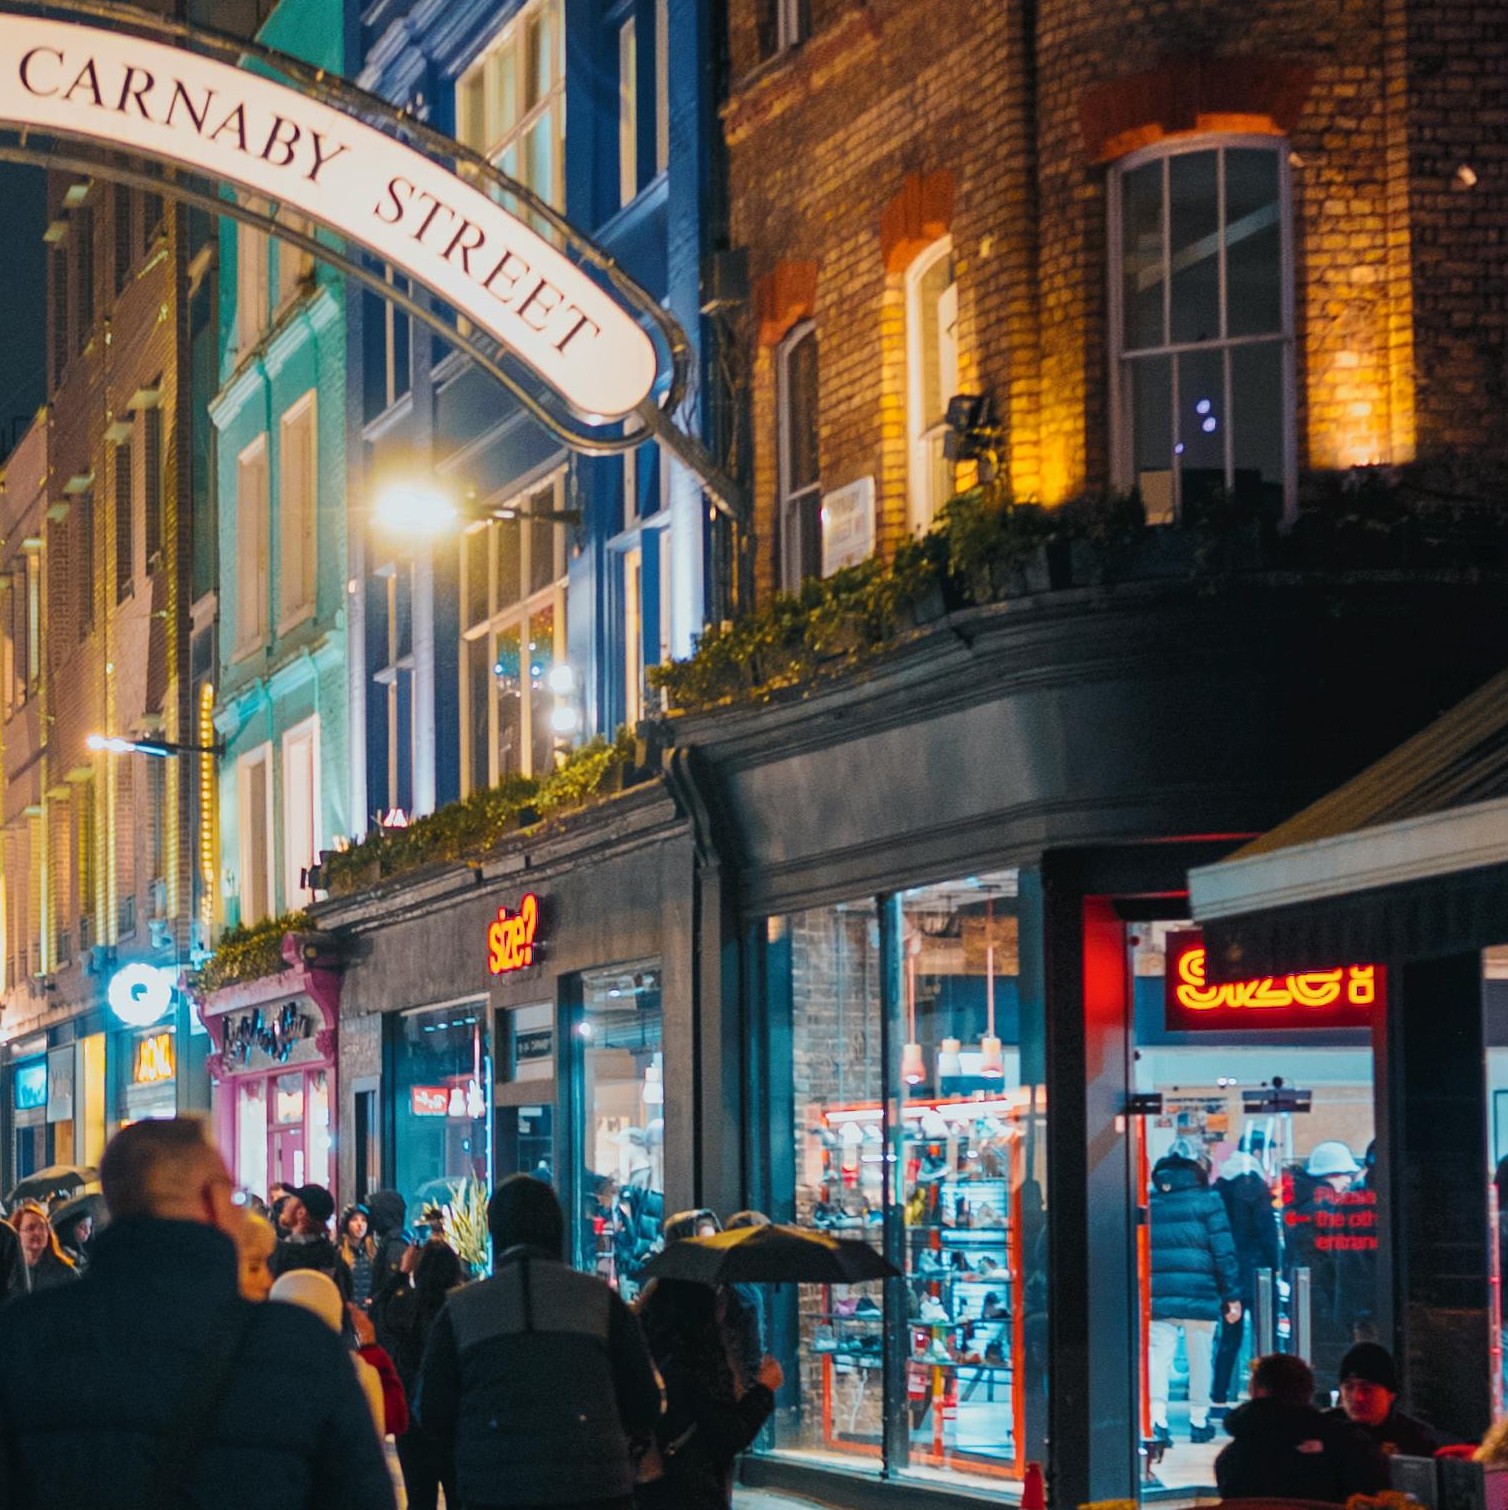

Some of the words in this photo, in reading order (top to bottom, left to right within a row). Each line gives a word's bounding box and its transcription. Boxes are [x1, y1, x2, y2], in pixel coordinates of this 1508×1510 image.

[19, 46, 350, 184] CARNABY
[373, 175, 602, 358] STREET
[487, 892, 538, 975] size?
